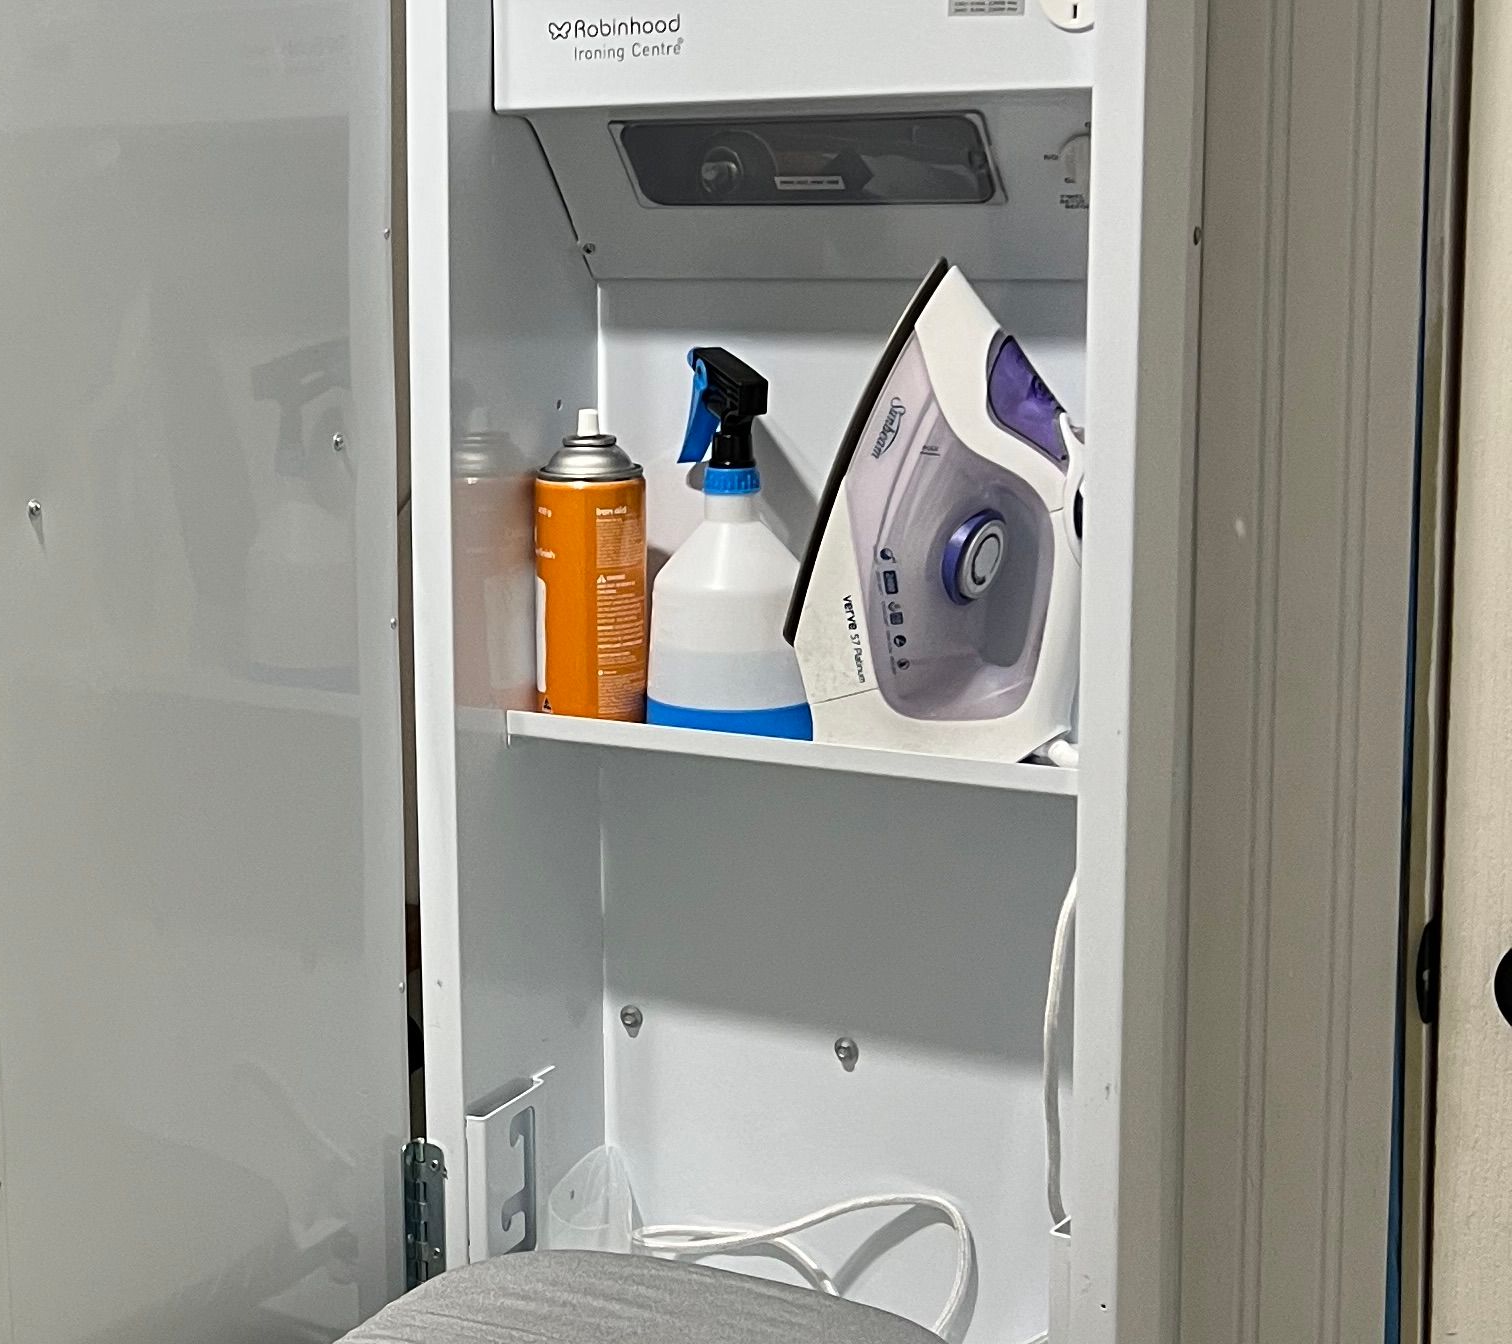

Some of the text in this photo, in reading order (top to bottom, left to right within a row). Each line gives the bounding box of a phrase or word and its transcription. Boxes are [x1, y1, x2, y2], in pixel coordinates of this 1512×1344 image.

[574, 13, 681, 38] Robinhood
[574, 43, 625, 62] Ironing
[871, 397, 906, 459] Sunbeam
[842, 594, 857, 630] verve
